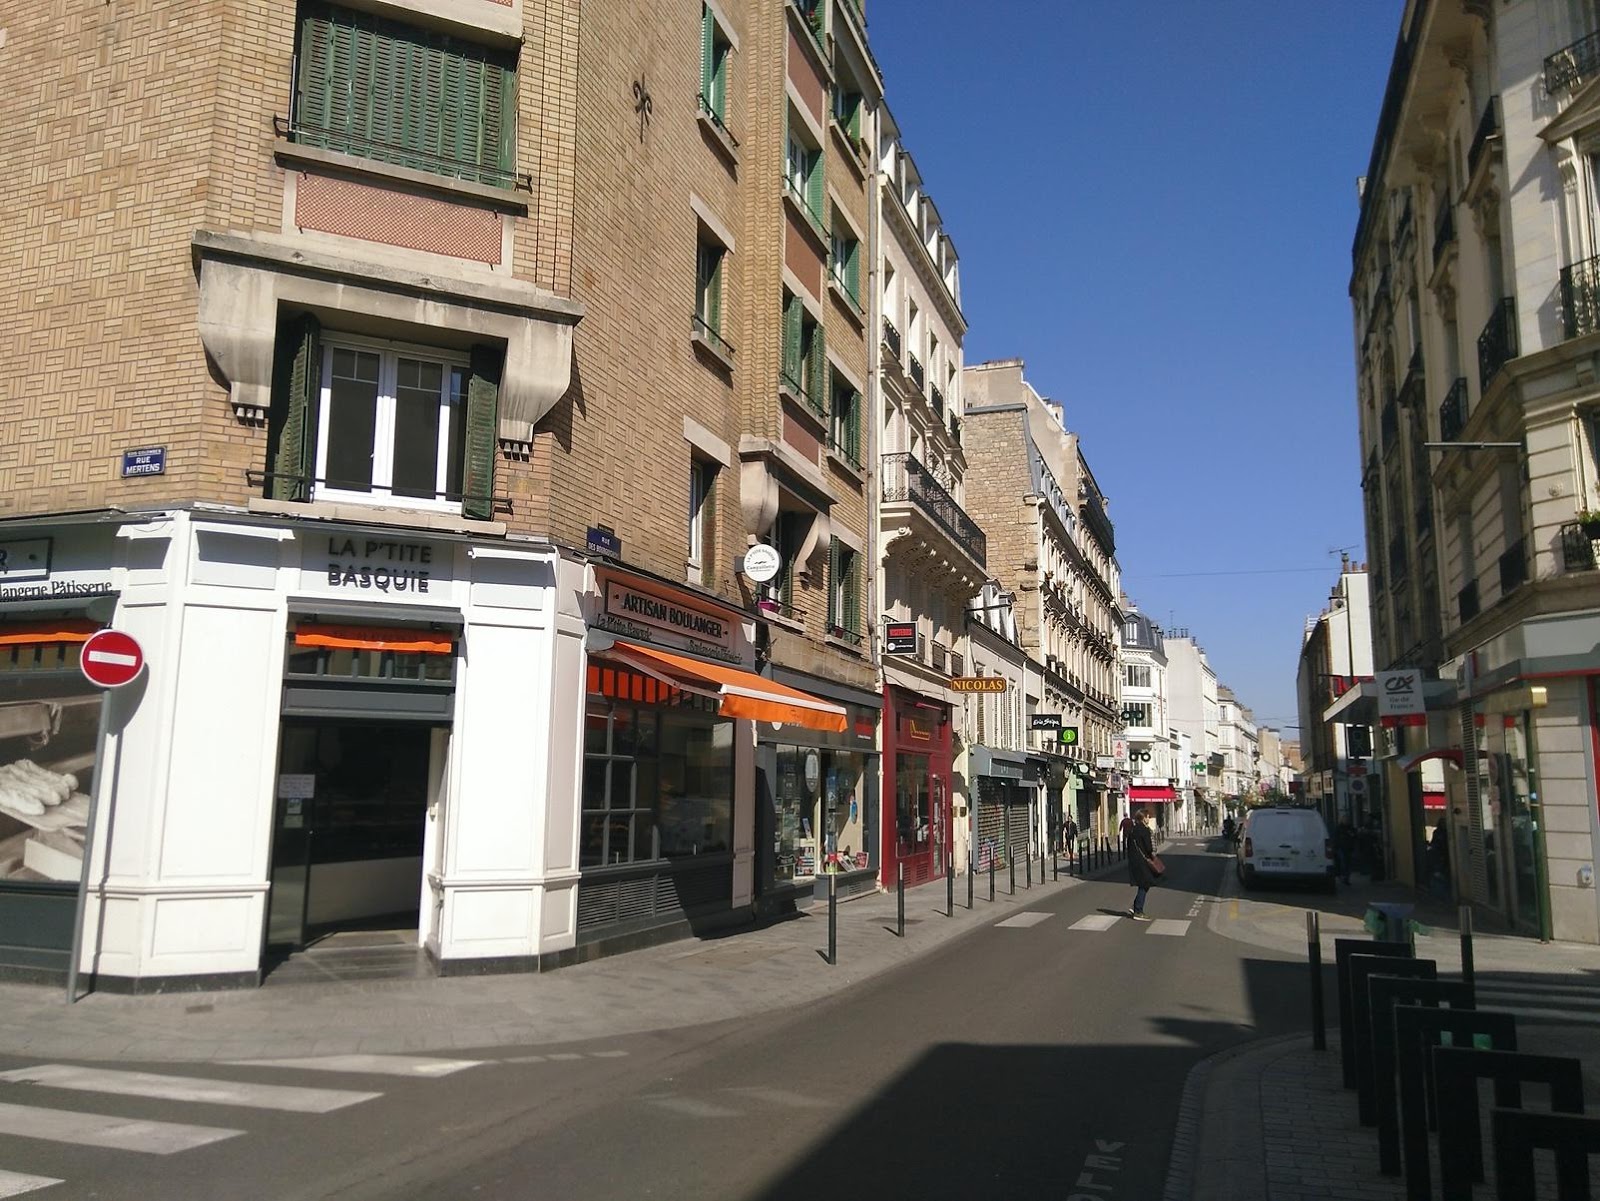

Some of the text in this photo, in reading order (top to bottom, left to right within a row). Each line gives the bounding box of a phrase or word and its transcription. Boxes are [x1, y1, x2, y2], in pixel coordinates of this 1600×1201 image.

[136, 456, 151, 464] RUE
[126, 463, 161, 474] MERTENS
[328, 537, 432, 564] LA P'TITE
[51, 580, 112, 595] Pâtisserie
[623, 593, 723, 638] ARTISAN BOULANGER
[952, 680, 1003, 690] NICOLAS
